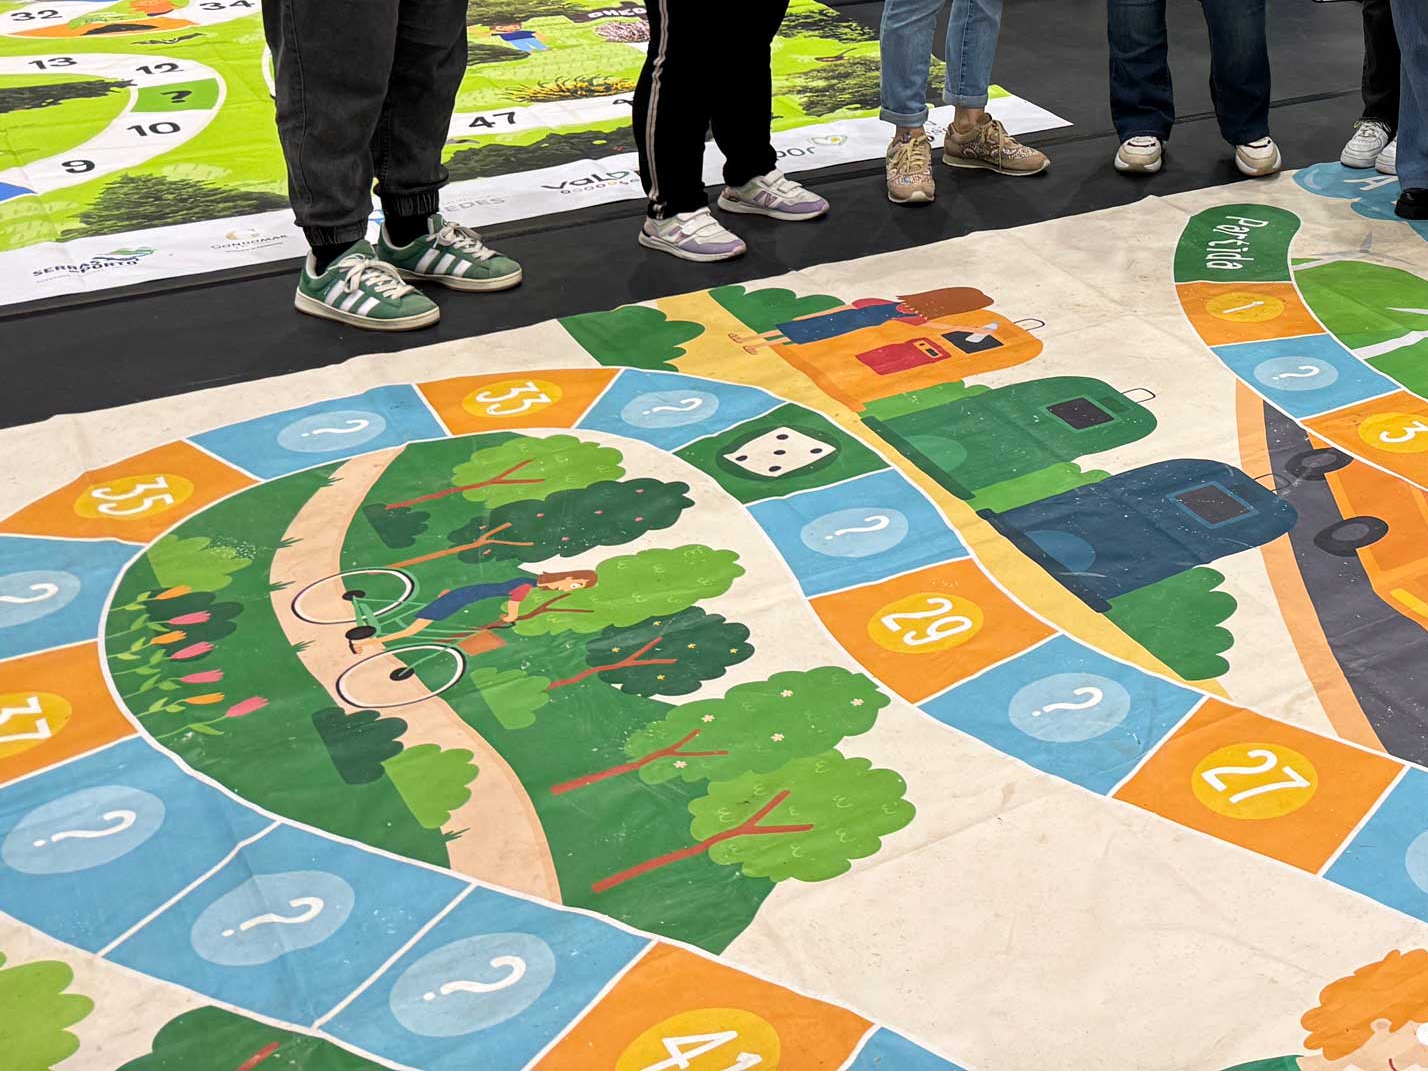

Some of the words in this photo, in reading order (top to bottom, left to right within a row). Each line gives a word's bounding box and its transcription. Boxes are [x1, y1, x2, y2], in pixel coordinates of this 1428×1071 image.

[10, 8, 63, 22] 32
[199, 0, 254, 12] 34
[28, 56, 78, 71] 13
[136, 62, 181, 76] 12
[159, 90, 193, 104] ?
[127, 121, 181, 138] 10
[469, 112, 518, 129] 47
[62, 159, 96, 174] 9
[1206, 214, 1269, 271] Partida
[32, 259, 100, 277] SERRAS
[1271, 364, 1320, 382] ?
[474, 380, 552, 417] 33
[90, 475, 175, 516] 35
[824, 514, 891, 541] ?
[879, 597, 974, 647] 29
[1032, 686, 1104, 717] ?
[1200, 749, 1311, 805] 27
[32, 809, 137, 848] ?
[221, 895, 325, 938] ?
[423, 955, 527, 1002] ?
